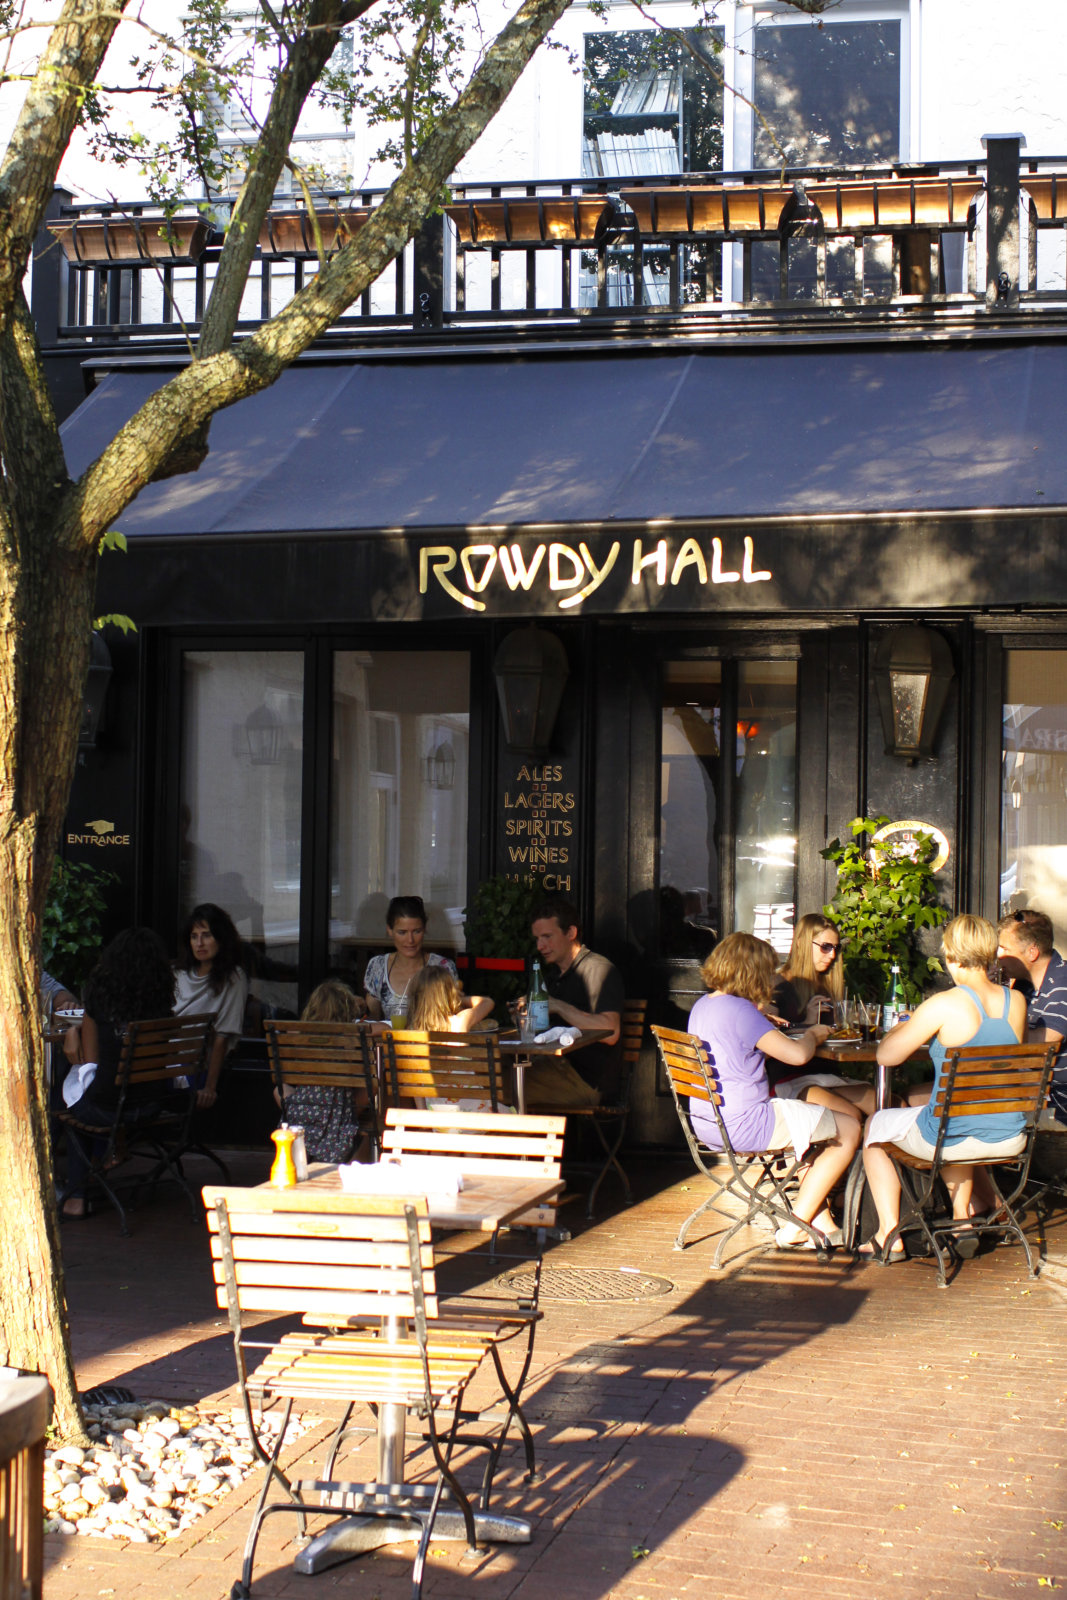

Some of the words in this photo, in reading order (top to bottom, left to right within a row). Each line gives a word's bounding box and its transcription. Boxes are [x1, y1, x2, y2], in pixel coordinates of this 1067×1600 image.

[419, 541, 620, 612] ROWDY
[631, 535, 772, 586] HALL
[516, 764, 563, 782] ALES
[504, 791, 576, 813] LAGERS
[505, 819, 573, 839] SPIRITS
[67, 833, 131, 847] ENTRANCE
[508, 846, 569, 864] WINES
